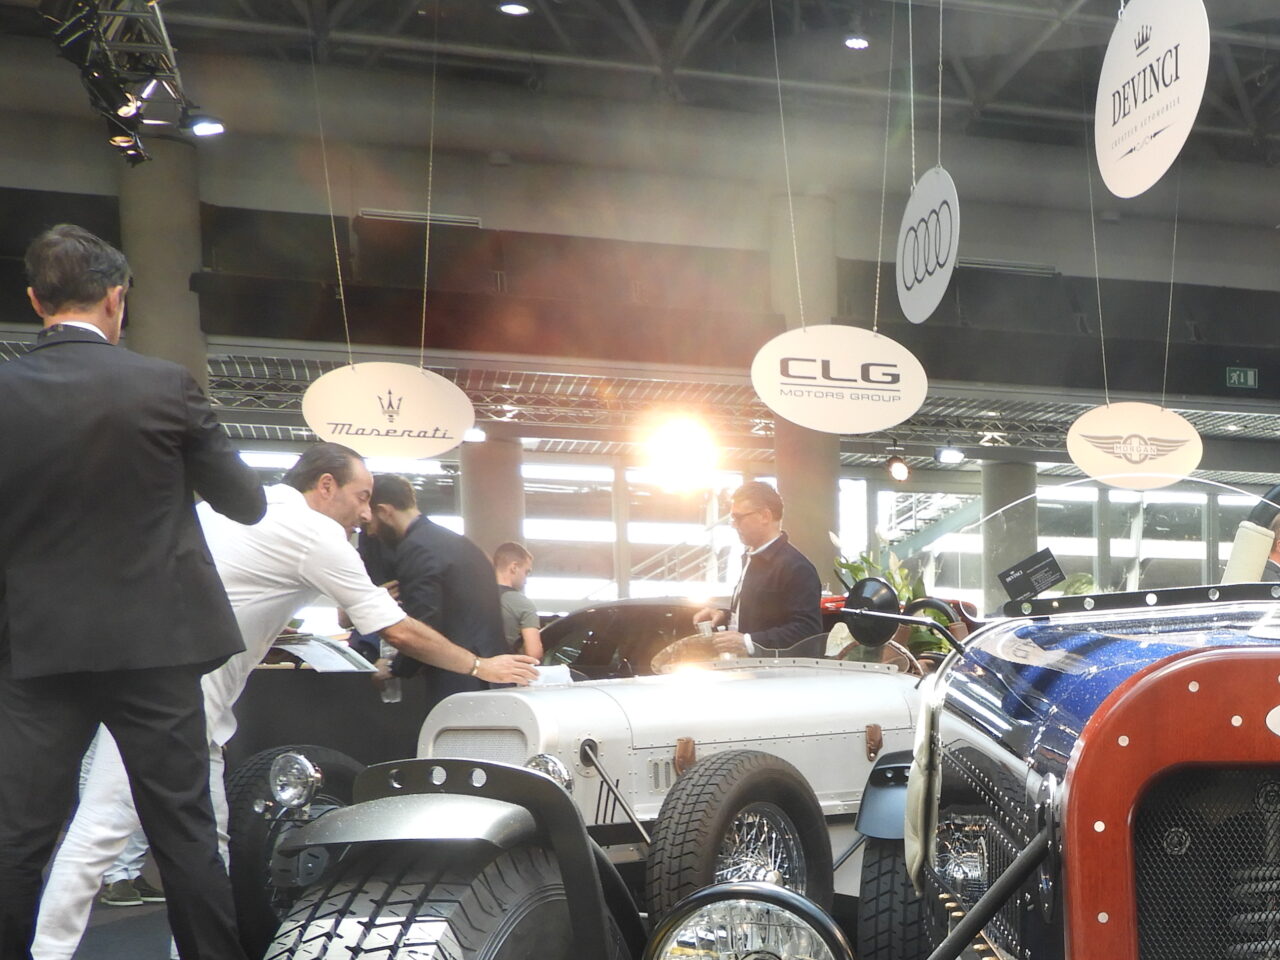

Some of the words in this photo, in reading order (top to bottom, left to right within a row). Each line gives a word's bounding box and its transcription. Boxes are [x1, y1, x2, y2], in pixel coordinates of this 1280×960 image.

[1111, 43, 1180, 127] DEVINCI
[780, 357, 900, 385] CLG
[780, 388, 845, 400] MOTORS
[850, 392, 901, 403] GROUP
[326, 422, 454, 440] Maserati
[1115, 445, 1156, 453] MORGAN
